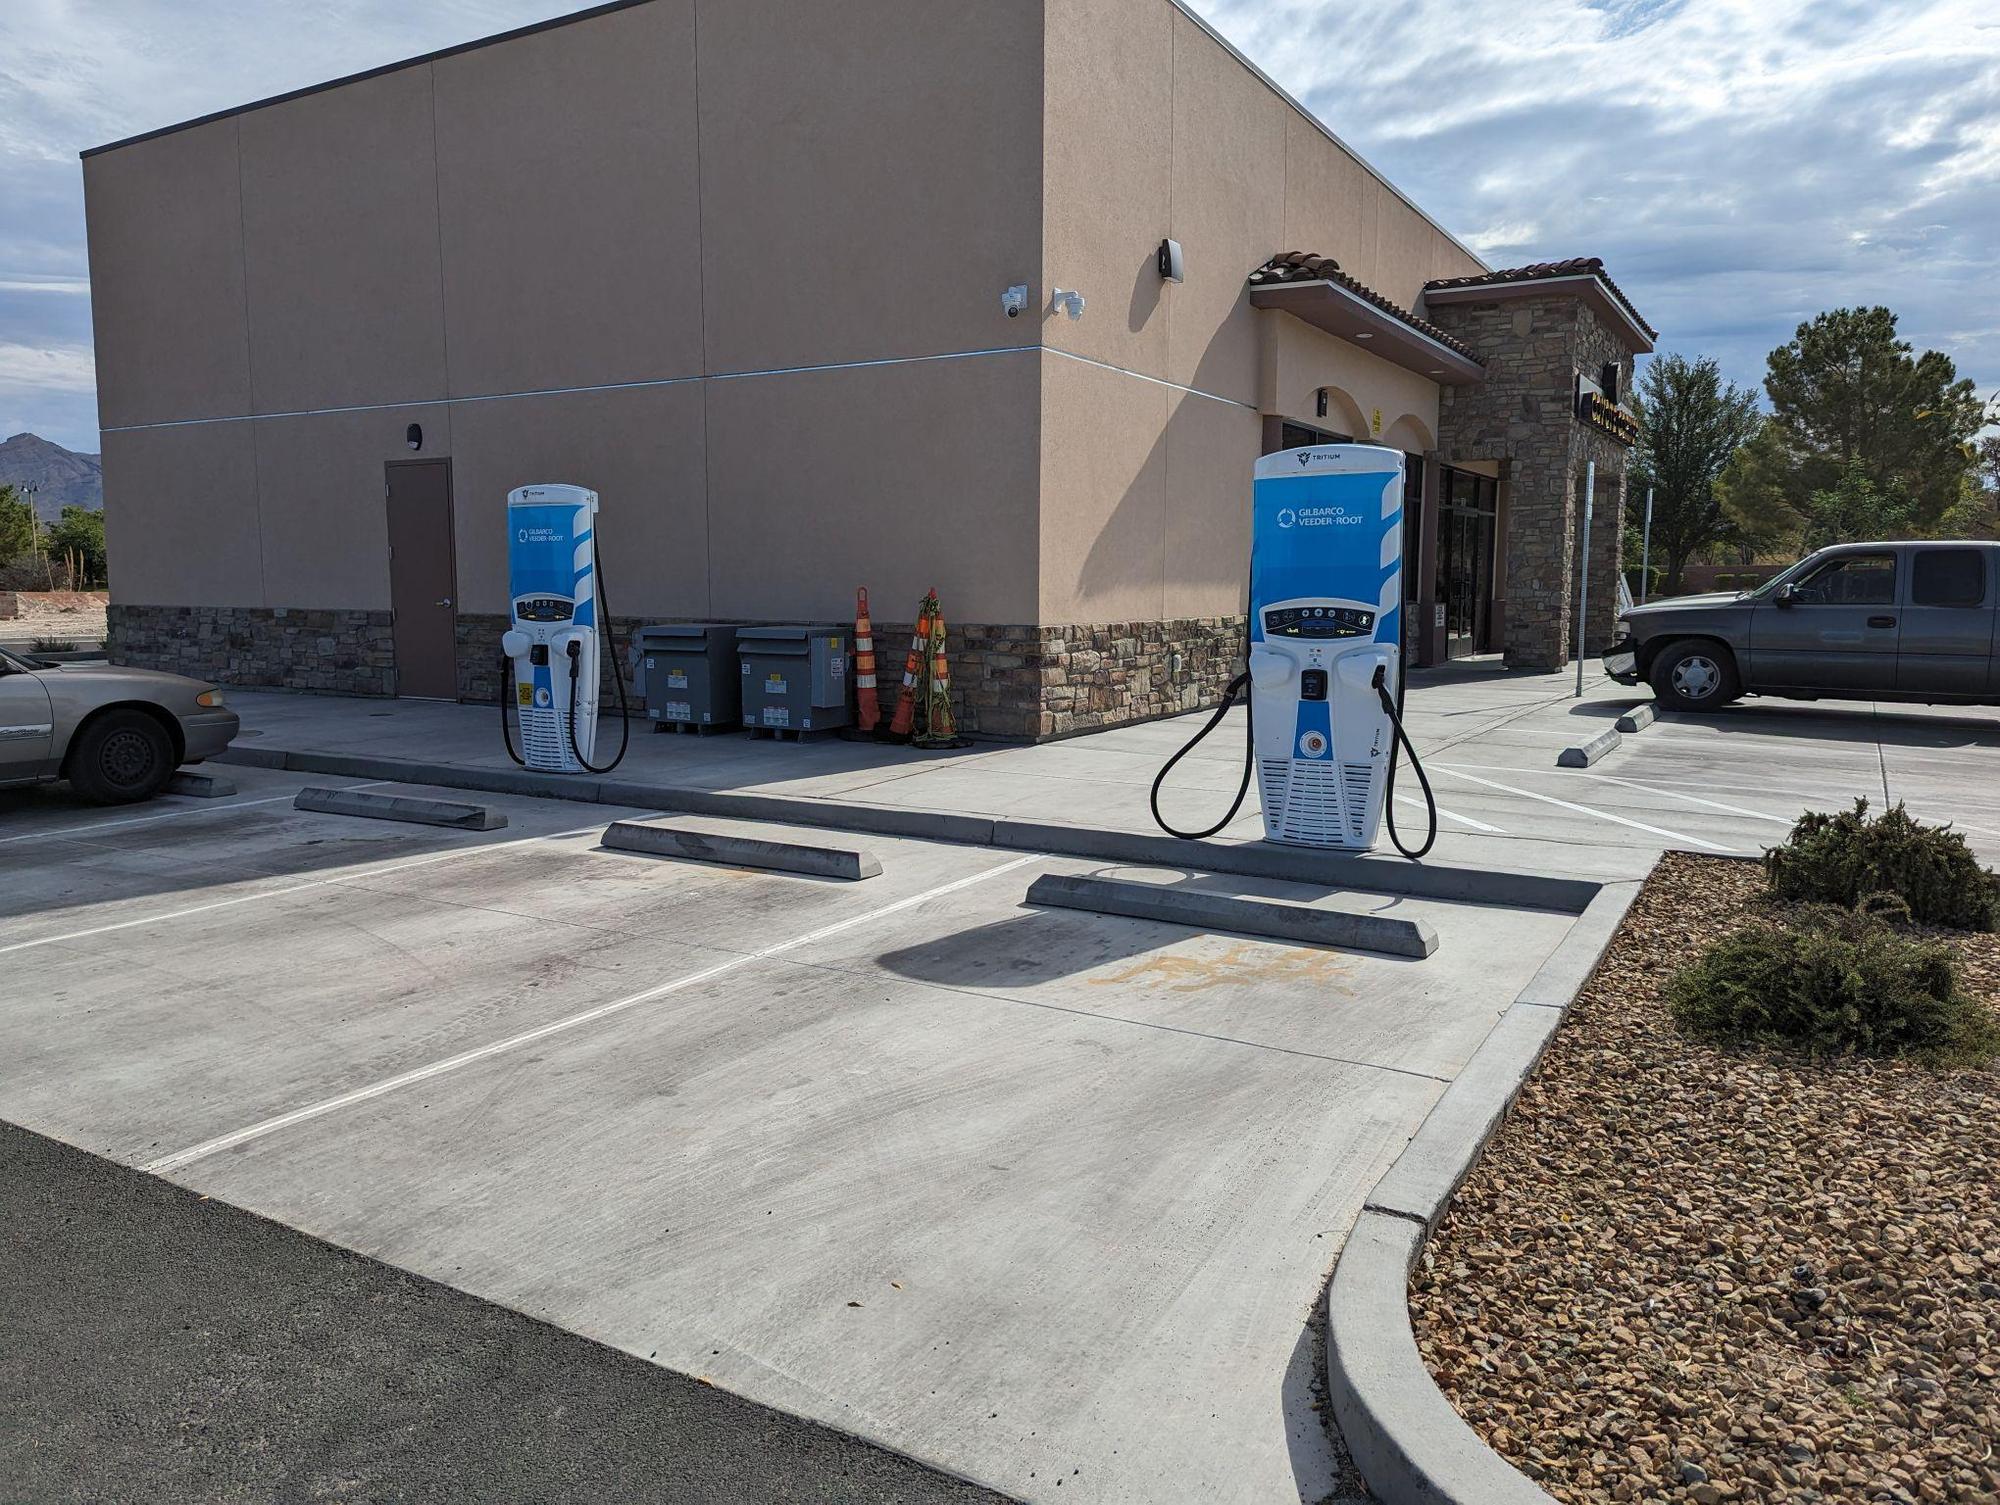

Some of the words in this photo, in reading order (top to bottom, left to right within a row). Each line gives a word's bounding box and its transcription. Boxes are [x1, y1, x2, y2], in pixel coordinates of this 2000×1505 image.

[1312, 453, 1341, 461] TRITIUM
[1299, 507, 1344, 516] GILBARCO
[1299, 516, 1363, 526] VEEDER-ROOT
